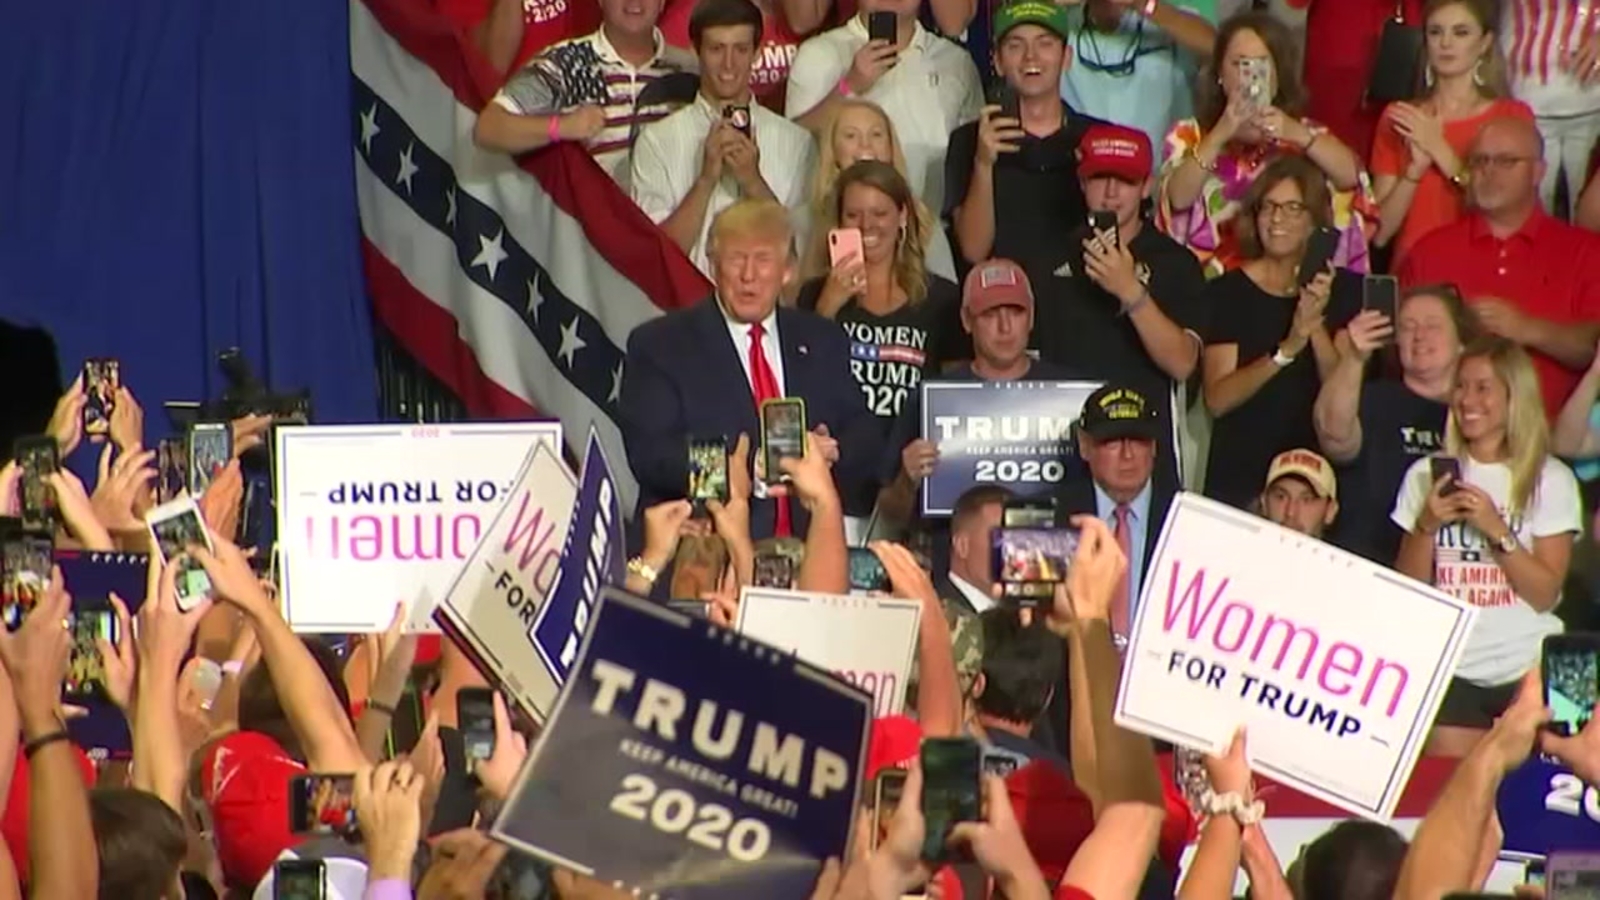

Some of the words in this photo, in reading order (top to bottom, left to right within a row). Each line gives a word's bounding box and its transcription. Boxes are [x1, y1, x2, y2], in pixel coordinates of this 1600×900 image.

[850, 359, 921, 389] RUMP
[935, 416, 1071, 441] TRUM
[328, 481, 442, 504] TRUMP
[975, 460, 1065, 482] 2020
[305, 513, 481, 562] omen
[494, 571, 537, 627] FOR
[559, 478, 612, 668] TRUMP
[1162, 559, 1410, 718] Women
[1167, 650, 1227, 690] FOR
[1240, 673, 1362, 738] TRUMP
[589, 658, 849, 800] TRUMP
[608, 773, 771, 862] 2020
